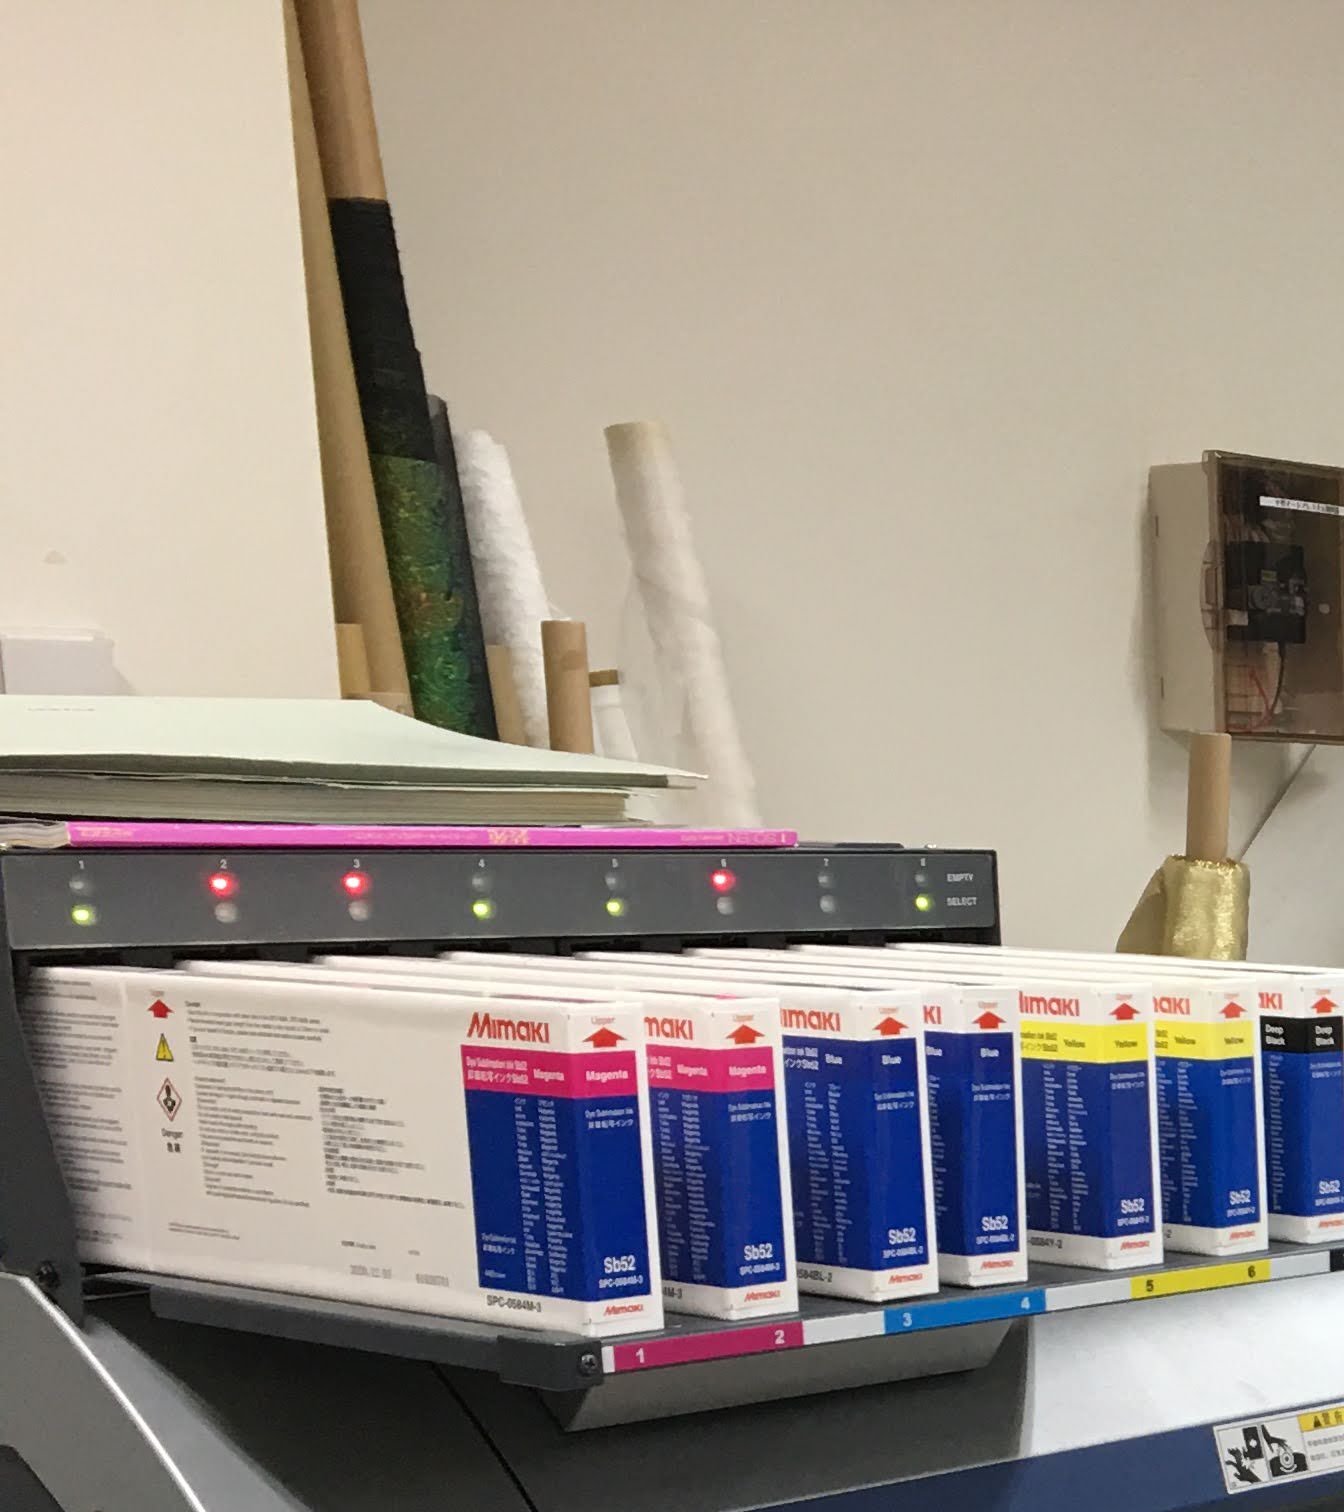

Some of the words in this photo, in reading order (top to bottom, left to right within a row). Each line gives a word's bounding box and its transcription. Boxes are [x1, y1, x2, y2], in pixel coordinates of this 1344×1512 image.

[946, 873, 975, 883] EMPTY
[946, 896, 978, 907] SELECT
[780, 1007, 841, 1032] imaki
[467, 1012, 549, 1044] Mimaki
[1265, 1024, 1284, 1036] Deep
[1315, 1026, 1333, 1036] Deep
[1063, 1038, 1085, 1048] Yellow
[1114, 1039, 1138, 1048] Yellow
[1265, 1036, 1286, 1046] Black
[1315, 1037, 1335, 1047] Black
[825, 1053, 843, 1065] Blue
[882, 1054, 902, 1065] Blue
[980, 1048, 999, 1058] Blue
[533, 1068, 565, 1082] Magenta
[585, 1069, 629, 1083] Magenta
[676, 1063, 708, 1077] Magenta
[729, 1064, 767, 1078] Magenta
[1318, 1179, 1342, 1195] Sb52
[1229, 1189, 1252, 1206] Sb52
[1120, 1198, 1145, 1214] Sb52
[981, 1215, 1009, 1232] Sb52
[888, 1227, 917, 1245] Sb52
[744, 1243, 773, 1261] Sb52
[1120, 1239, 1150, 1251] Mimaki
[603, 1255, 637, 1274] Sb52
[981, 1259, 1014, 1270] Mimaki
[888, 1273, 923, 1285] Mimaki
[1246, 1265, 1256, 1279] 6
[1145, 1280, 1154, 1293] 5
[744, 1290, 781, 1302] Mimaki
[1020, 1296, 1030, 1310] 4
[603, 1303, 645, 1317] Mimaki
[902, 1312, 912, 1328] 3
[774, 1329, 786, 1345] 2
[635, 1347, 646, 1364] 1
